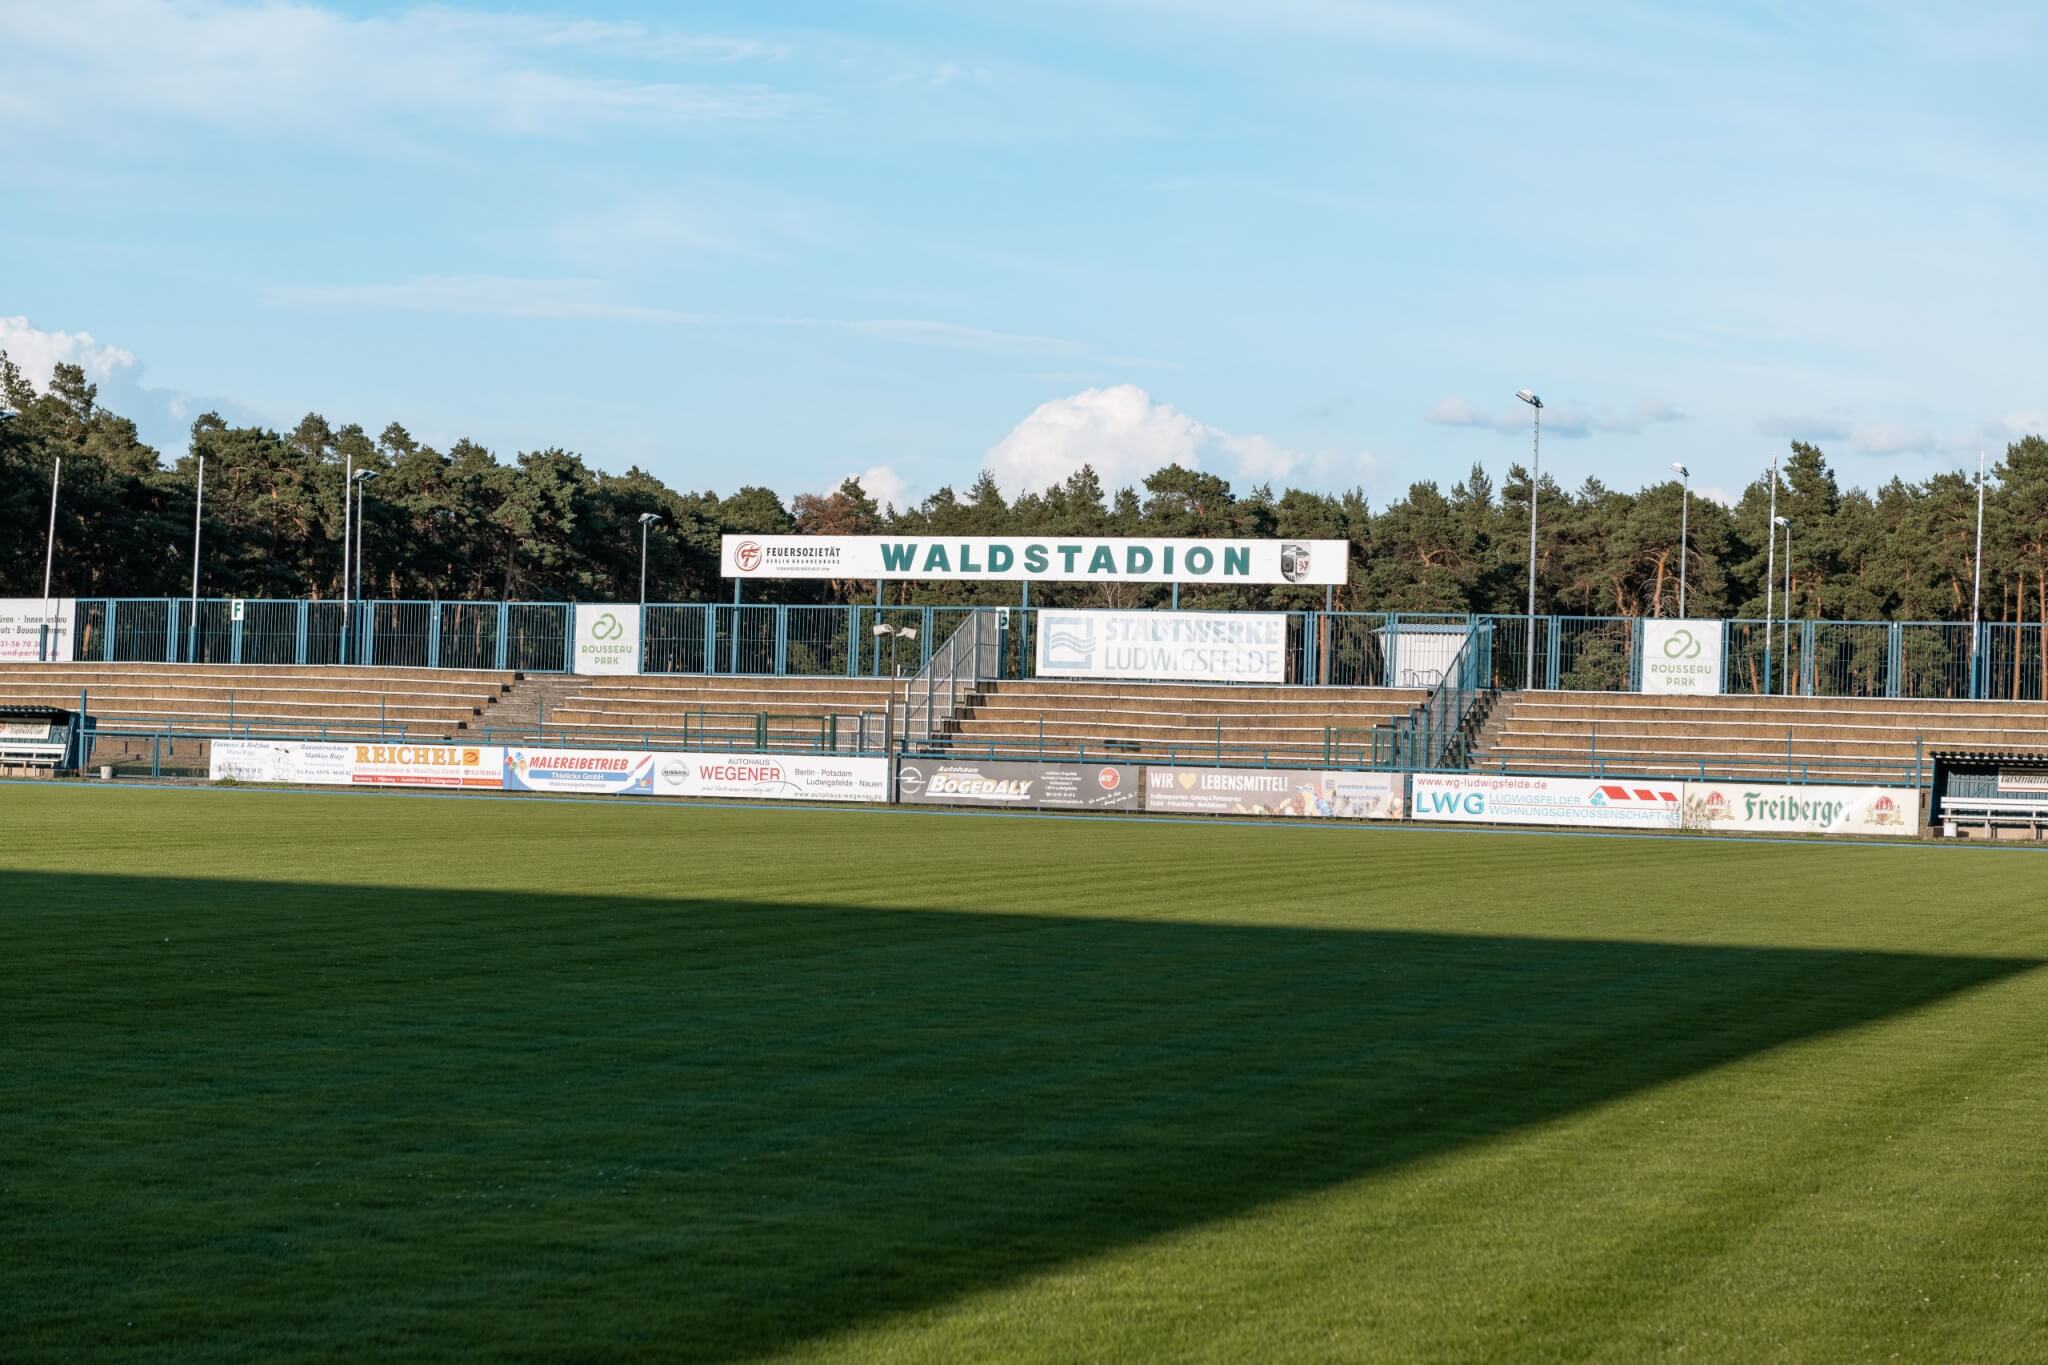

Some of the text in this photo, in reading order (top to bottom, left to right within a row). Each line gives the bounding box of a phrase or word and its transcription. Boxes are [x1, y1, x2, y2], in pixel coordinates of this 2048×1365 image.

[766, 546, 840, 557] FEUERSOZIETÄT
[880, 543, 1250, 576] WALDSTADION
[234, 602, 241, 618] F
[1106, 618, 1279, 645] STADTWERKE
[582, 645, 632, 654] ROUSSEAU
[594, 656, 619, 665] PARK
[1651, 664, 1712, 674] ROUSSEAU
[1666, 677, 1696, 686] PARK
[355, 746, 460, 766] REICHEL
[727, 758, 770, 766] AUTOHAUS
[529, 757, 629, 770] MALEREIBETRIEB
[699, 766, 780, 782] WEGENER
[795, 768, 853, 777] Berlin Potsdam
[806, 778, 883, 788] Ludwigsfelde Nauen
[1150, 772, 1288, 792] WIR LEBENSMITTEL!
[1418, 777, 1548, 790] www.wg-ludwigsfelde.de
[1417, 791, 1485, 815] LWG
